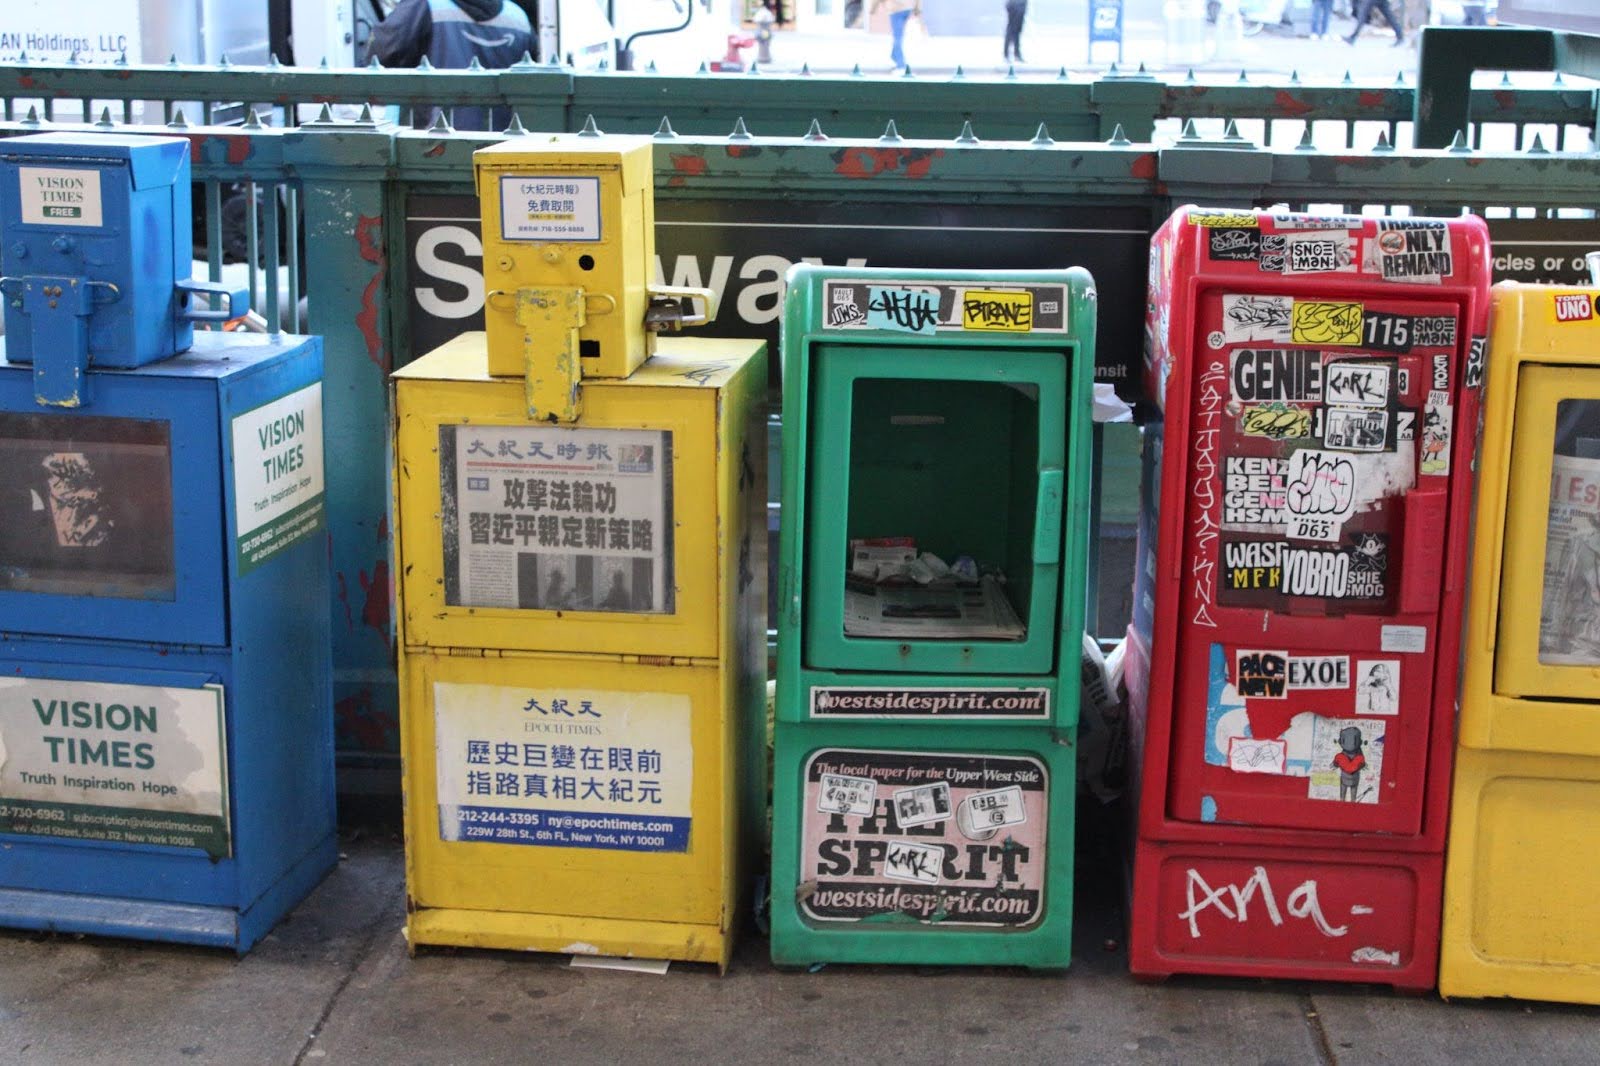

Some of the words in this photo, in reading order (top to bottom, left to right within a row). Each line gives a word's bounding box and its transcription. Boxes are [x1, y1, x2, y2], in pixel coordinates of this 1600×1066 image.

[26, 33, 94, 54] Holdings,
[99, 35, 127, 52] LLC
[37, 176, 84, 189] VISION
[41, 190, 84, 202] TIMES
[50, 207, 74, 217] FREE
[1382, 252, 1451, 277] REMAND
[1543, 257, 1564, 271] or
[1556, 300, 1590, 320] UNO
[1368, 316, 1408, 346] 115
[1095, 364, 1127, 377] nsit
[1234, 350, 1321, 400] GENIE
[258, 409, 304, 450] VISION
[263, 444, 304, 484] TIMES
[503, 478, 617, 514] 攻擊法輪功
[469, 512, 653, 551] 習近平親定新策略
[1297, 524, 1330, 538] D65
[1282, 549, 1350, 598] YOBRO
[1288, 659, 1347, 686] EXOE
[32, 698, 157, 733] VISION
[523, 698, 602, 718] 大紀元
[524, 722, 563, 735] EPOCH
[567, 724, 602, 736] TIMES
[43, 736, 155, 770] TIMES
[467, 740, 661, 774] 歷史巨變在眼前
[20, 771, 56, 786] Truth
[63, 775, 135, 792] Inspiration
[142, 781, 177, 796] Hope
[816, 762, 838, 775] The
[840, 764, 868, 776] local
[871, 768, 904, 780] paper
[905, 767, 924, 780] for
[926, 769, 945, 780] the
[946, 768, 982, 782] Upper
[983, 769, 1012, 782] West
[1014, 770, 1039, 783] Side
[467, 771, 662, 804] 指路真相大紀元
[73, 812, 213, 834] subscription@visiontimes.com
[458, 810, 539, 826] 212-244-3395
[548, 816, 673, 833] ny@epochtimes.com
[125, 832, 145, 843] New
[146, 833, 167, 844] York
[467, 826, 494, 837] 229W
[496, 828, 518, 838] 28th
[536, 829, 552, 840] 6th
[571, 832, 592, 843] New
[595, 833, 619, 846] York,
[621, 834, 634, 845] NY
[637, 836, 664, 847] 10001
[817, 838, 1029, 882] SPRIT
